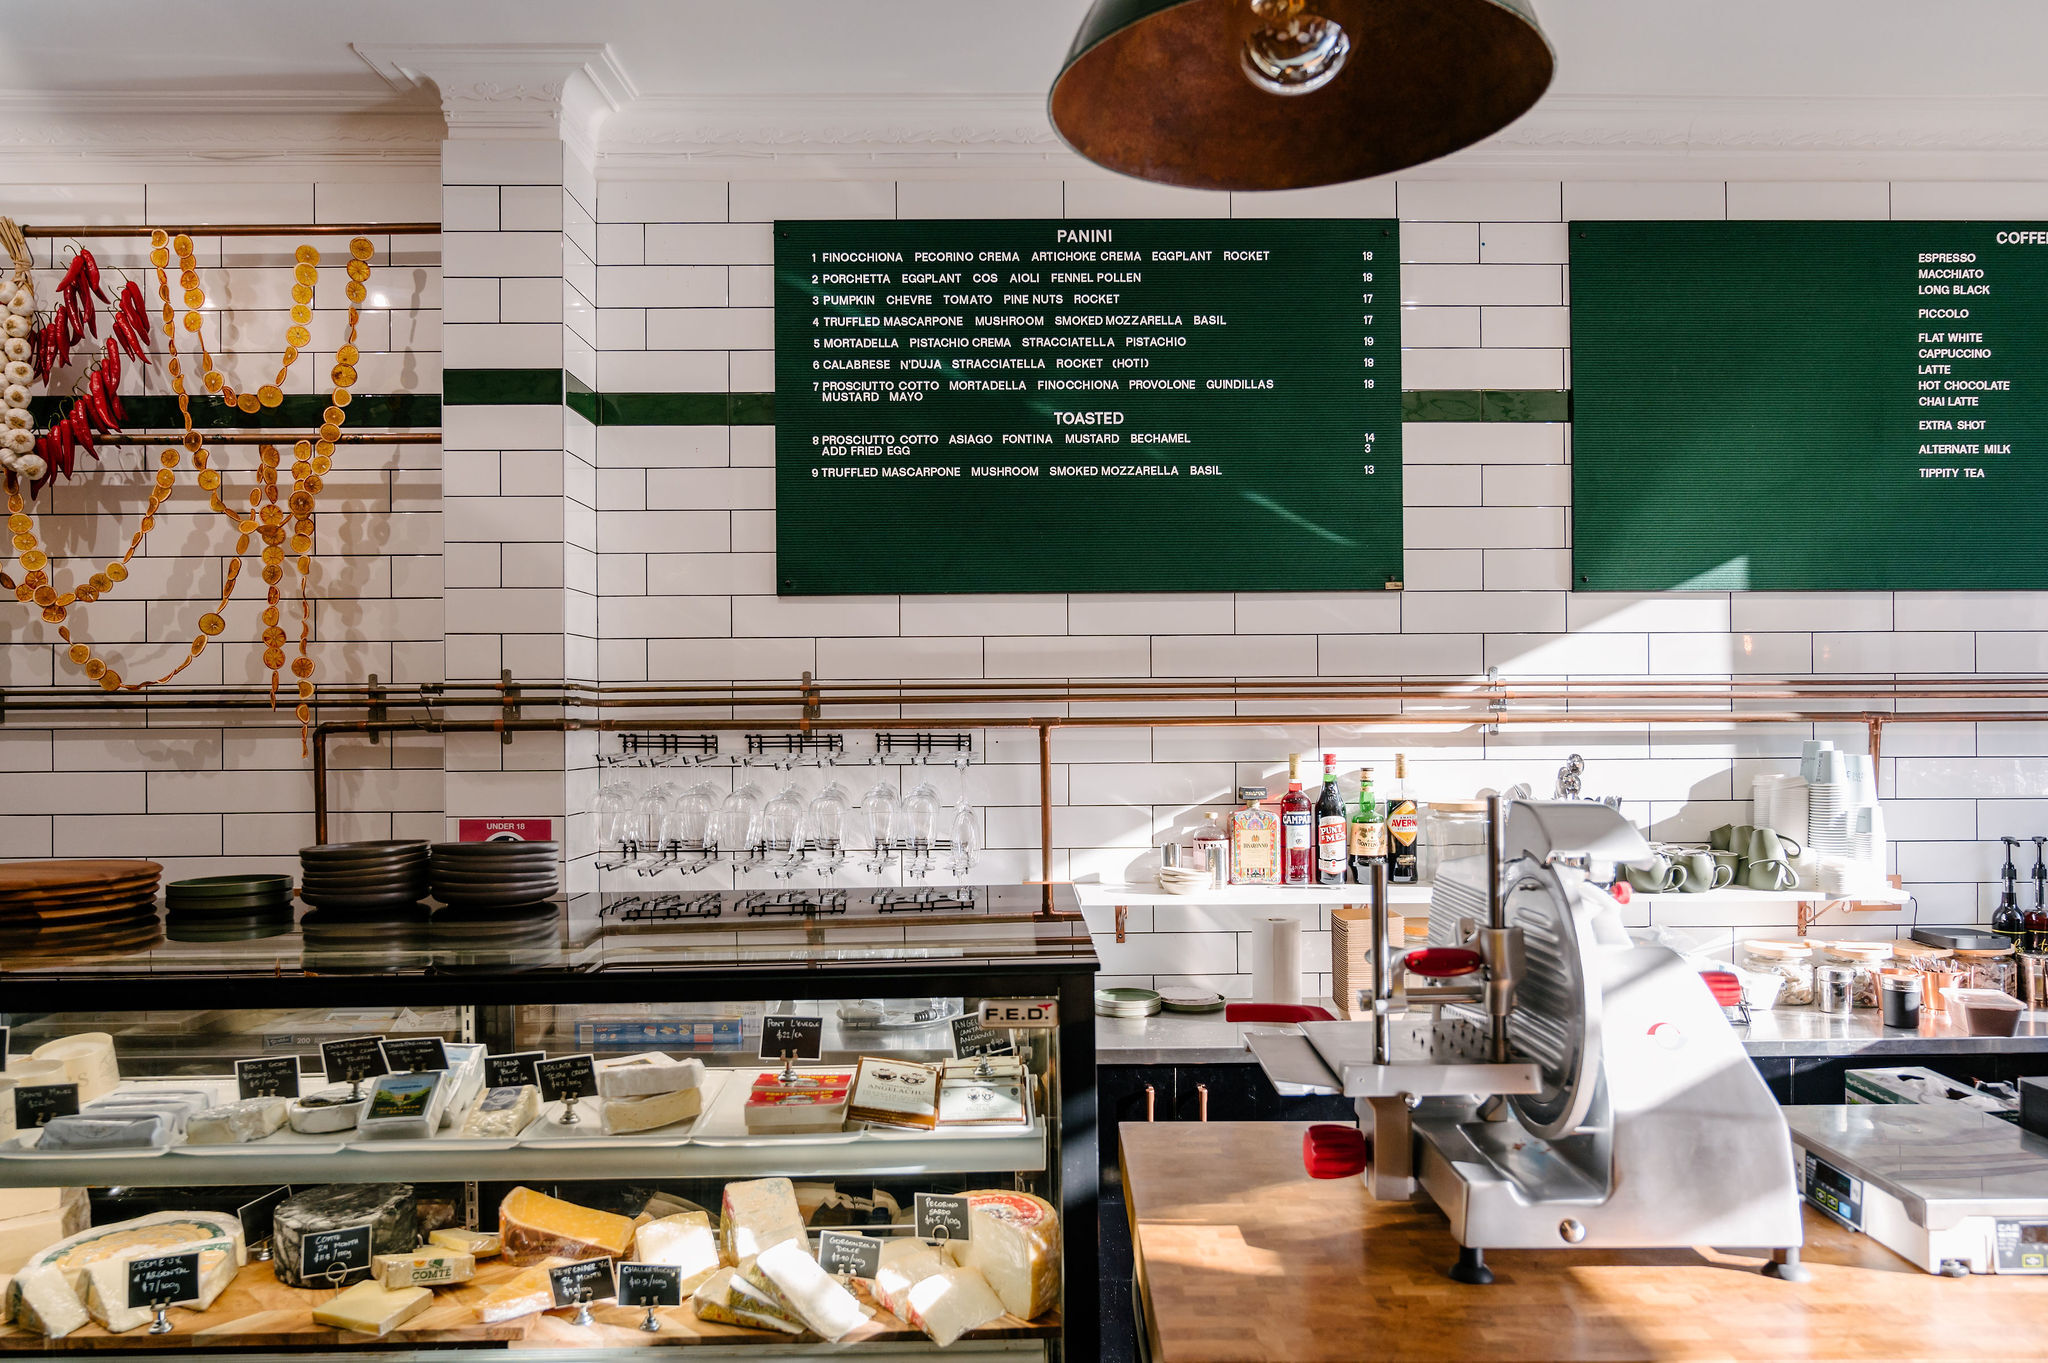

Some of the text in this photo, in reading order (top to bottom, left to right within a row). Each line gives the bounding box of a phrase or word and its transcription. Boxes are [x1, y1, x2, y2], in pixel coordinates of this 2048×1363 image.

[1058, 230, 1111, 242] PANINI
[812, 251, 1372, 262] 1 FINOCCHIONA PECORINO CREMA ARTICHOKE CREMA EGGPLANT ROCKET 18
[1919, 253, 1976, 262] ESPRESSO
[812, 273, 1372, 284] 2 PORCHETTA EGGPLANT COS AIOLI FENNEL POLLEN 18
[1919, 269, 1984, 278] MACCHIATO
[1919, 285, 1990, 294] LONG BLACK
[813, 294, 1373, 305] 3 PUMPKIN CHEVRE TOMATO PINE NUTS ROCKET 17
[1919, 309, 1969, 318] PICCOLO
[813, 315, 1373, 326] 4 TRUFFLED MASCARPONE MUSHROOM SMOKED MOZZARELLA BASIL 17
[814, 337, 1373, 348] 5 MORTADELLA PISTACHIO CREMA STRACCIATELLA PISTACHIO 19
[1919, 333, 1982, 342] FLAT WHITE
[1919, 349, 1991, 358] CAPPUCCINO
[813, 358, 1373, 369] 6 CALABRESE N'DUJA STRACCIATELLA ROCKET (HOT!) 18
[1919, 365, 1951, 374] LATTE
[813, 380, 1374, 391] 7 PROSCIUTTO COTTO MORTADELLA FINOCCHIONA PROVOLONE GUINDILLAS 18
[1919, 381, 2010, 390] HOT CHOCOLATE
[823, 392, 923, 401] MUSTARD MAYO
[1919, 397, 1978, 406] CHAI LATTE
[1054, 412, 1123, 424] TOASTED
[1919, 421, 1986, 430] EXTRA SHOT
[813, 433, 1375, 445] 8 PROSCIUTTO COTTO ASIAGO FONTINA MUSTARD BECHAMEL 14
[822, 444, 1370, 455] ADD FRIED EGG 3
[1919, 445, 2010, 454] ALTERNATE MILK
[812, 465, 1374, 477] 9 TRUFFLED MASCARPONE MUSHROOM SMOKED MOZZARELLA BASIL 13
[1919, 468, 1984, 477] TIPPITY TEA
[1391, 819, 1417, 827] AVERN
[1320, 825, 1342, 835] PUNT
[1326, 833, 1346, 842] MES
[985, 1008, 1049, 1021] F.E.D.
[767, 1018, 785, 1028] PONT
[953, 1018, 978, 1031] ANGEL
[959, 1024, 983, 1036] CANTA
[296, 1037, 311, 1045] 200
[925, 1197, 959, 1208] PECORINO
[929, 1208, 951, 1216] SARDO
[334, 1238, 359, 1248] MONTH
[835, 1244, 860, 1254] DOLCE
[576, 1271, 602, 1282] MONTH
